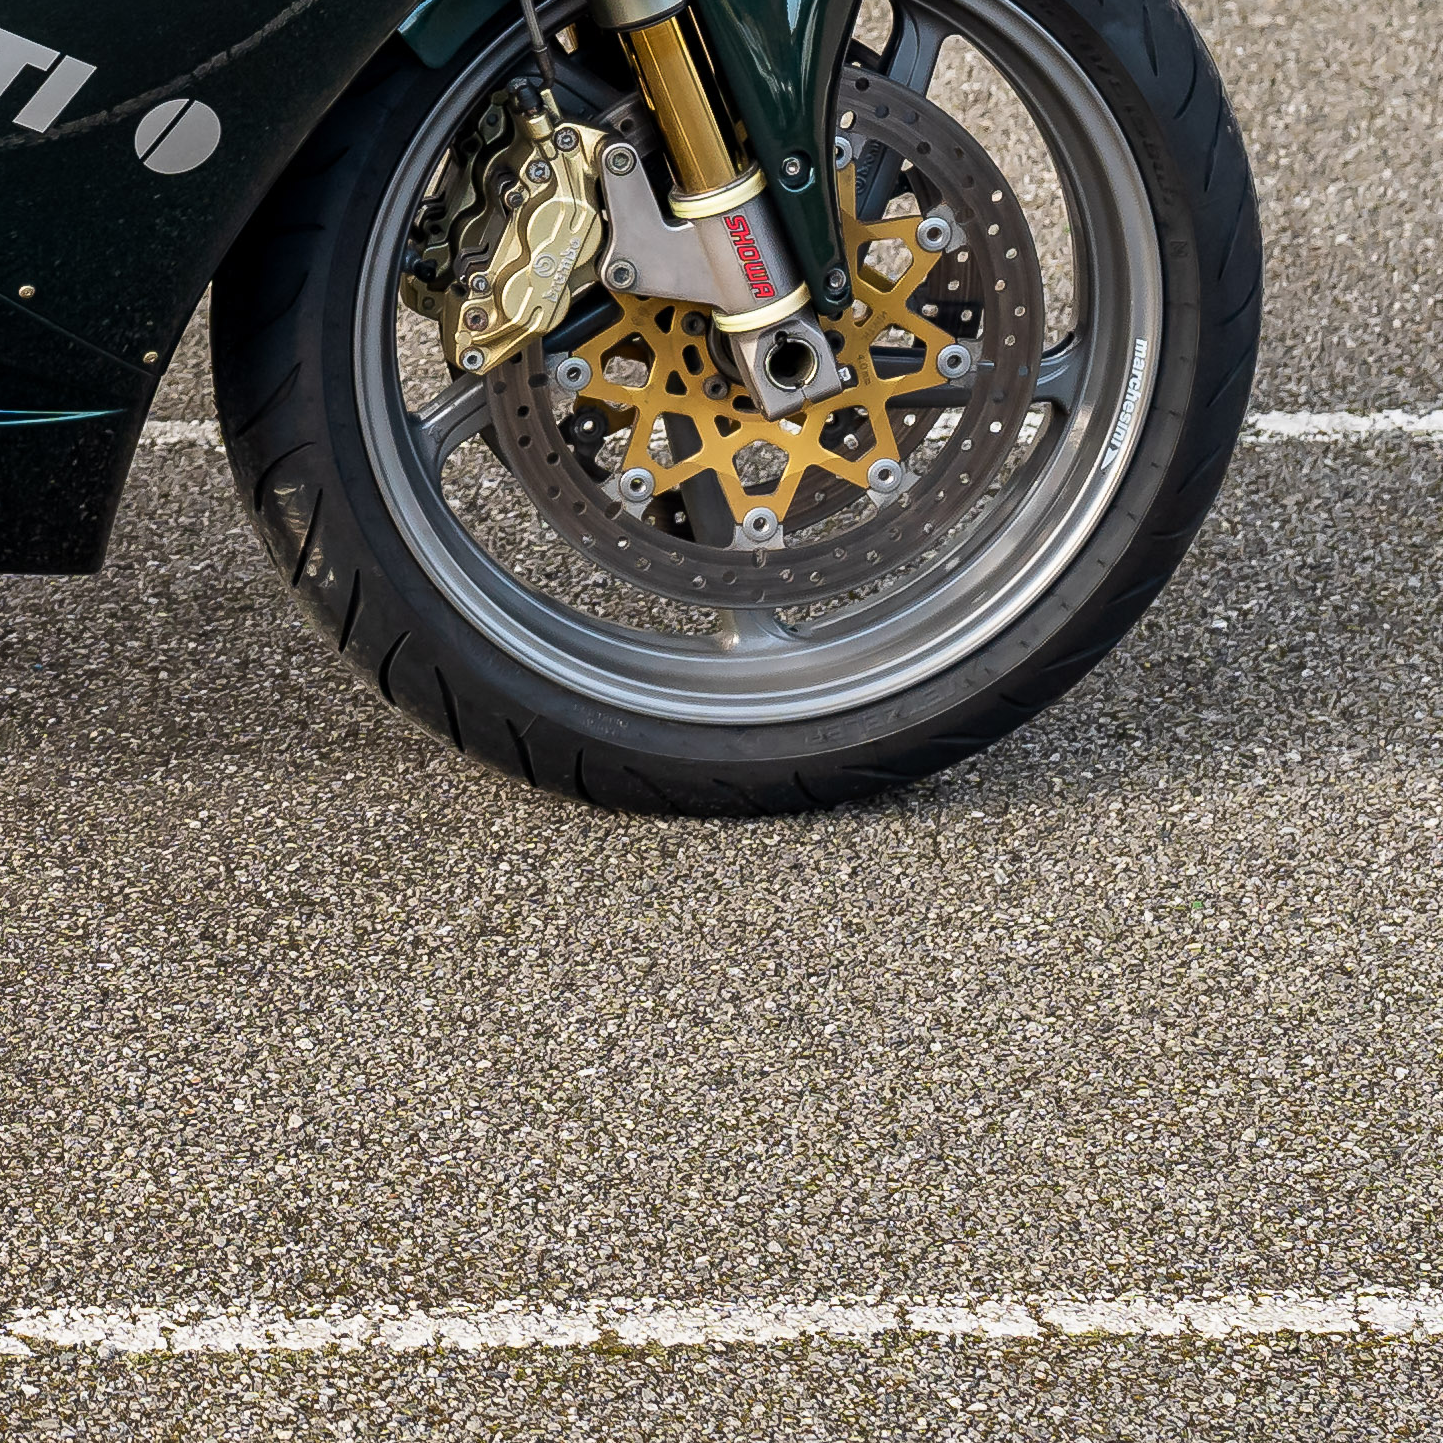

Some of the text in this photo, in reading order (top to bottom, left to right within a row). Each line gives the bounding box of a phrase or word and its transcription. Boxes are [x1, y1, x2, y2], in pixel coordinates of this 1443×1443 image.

[542, 239, 580, 303] brembo
[722, 214, 776, 298] SHOWA
[1110, 338, 1148, 447] marchesini
